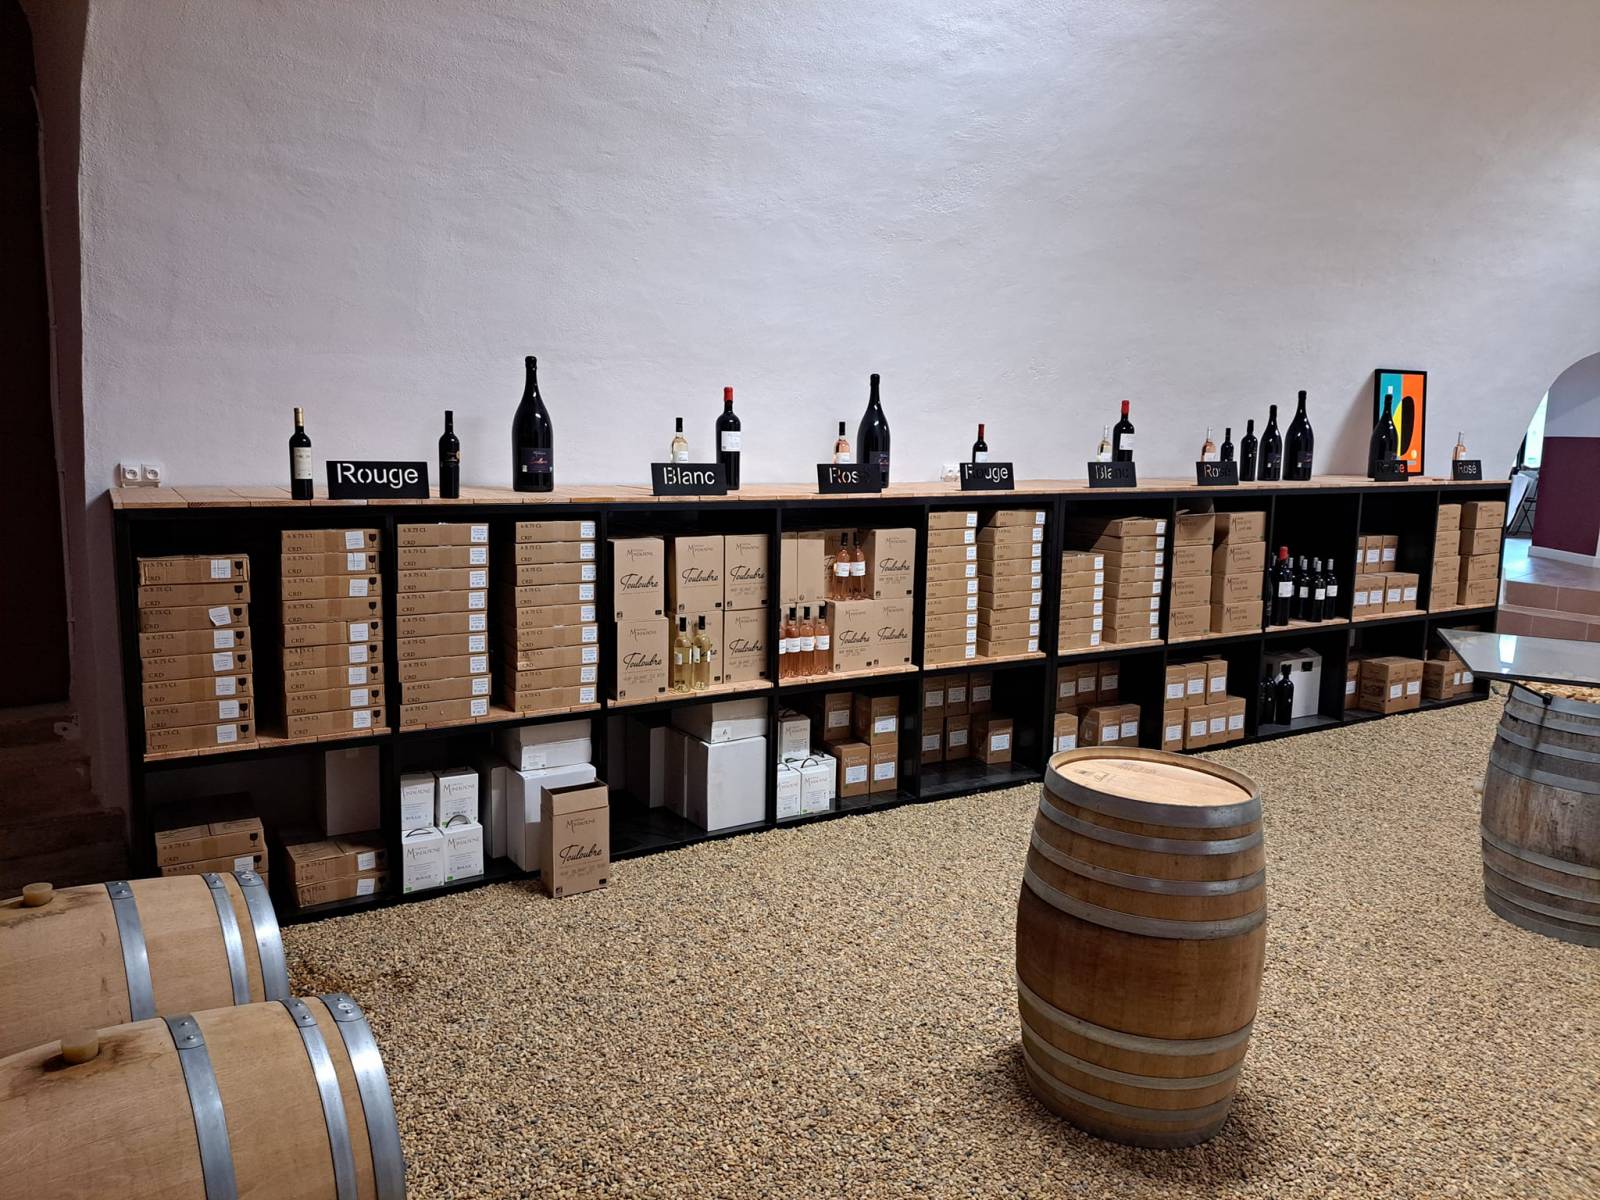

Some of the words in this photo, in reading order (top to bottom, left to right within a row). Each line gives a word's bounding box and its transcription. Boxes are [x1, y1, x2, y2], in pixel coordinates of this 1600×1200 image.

[337, 463, 419, 489] Rouge
[663, 467, 715, 485] Blanc
[829, 467, 861, 484] Ros
[879, 557, 910, 573] Touloubre
[620, 573, 659, 591] Touloubre
[681, 567, 719, 584] Touloubre
[729, 565, 766, 583] Touloubre
[838, 630, 870, 646] Touloubre
[877, 626, 908, 642] Touloubre
[728, 639, 763, 655] Touloubre
[623, 652, 662, 670] Touloubre
[559, 843, 603, 865] Touloubre
